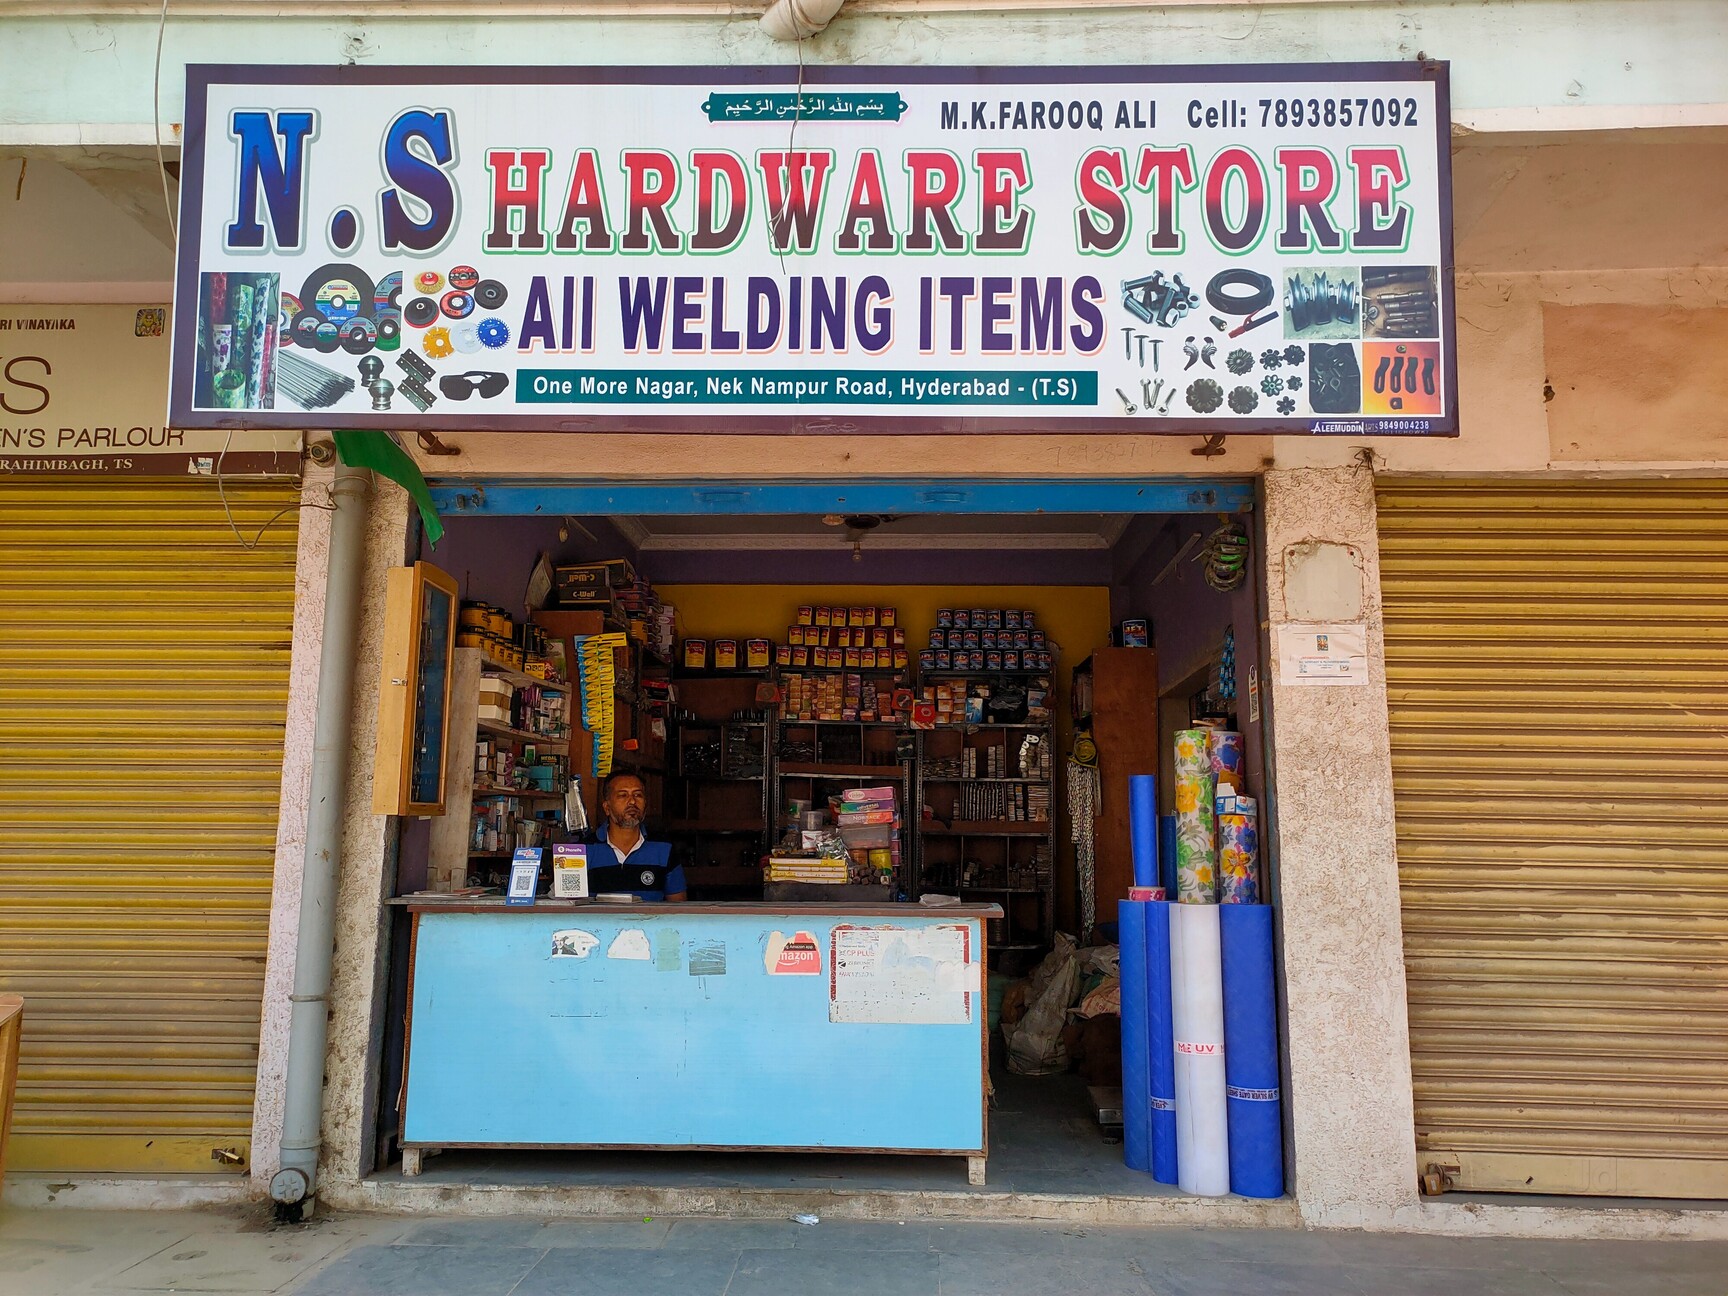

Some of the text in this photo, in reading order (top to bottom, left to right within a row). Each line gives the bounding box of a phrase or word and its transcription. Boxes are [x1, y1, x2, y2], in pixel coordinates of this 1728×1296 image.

[940, 97, 1419, 131] M.K.FAROOQ ALI Cell: 7893857092
[485, 150, 1032, 256] HARDWARE
[1077, 145, 1410, 254] STORE
[517, 274, 1104, 354] All WELDING ITEMS
[533, 376, 572, 394] One
[580, 376, 628, 394] More
[635, 376, 698, 398] Nagar,
[706, 377, 743, 394] Nek
[751, 377, 829, 399] Nampur
[836, 377, 893, 397] Road,
[901, 377, 1010, 399] Hyderabad
[1031, 378, 1078, 400] (T.S)
[1379, 420, 1430, 430] 9849004238
[57, 426, 185, 448] PARLOUR
[0, 458, 133, 472] RAHIMBAGH, TS
[1195, 1044, 1215, 1053] UV
